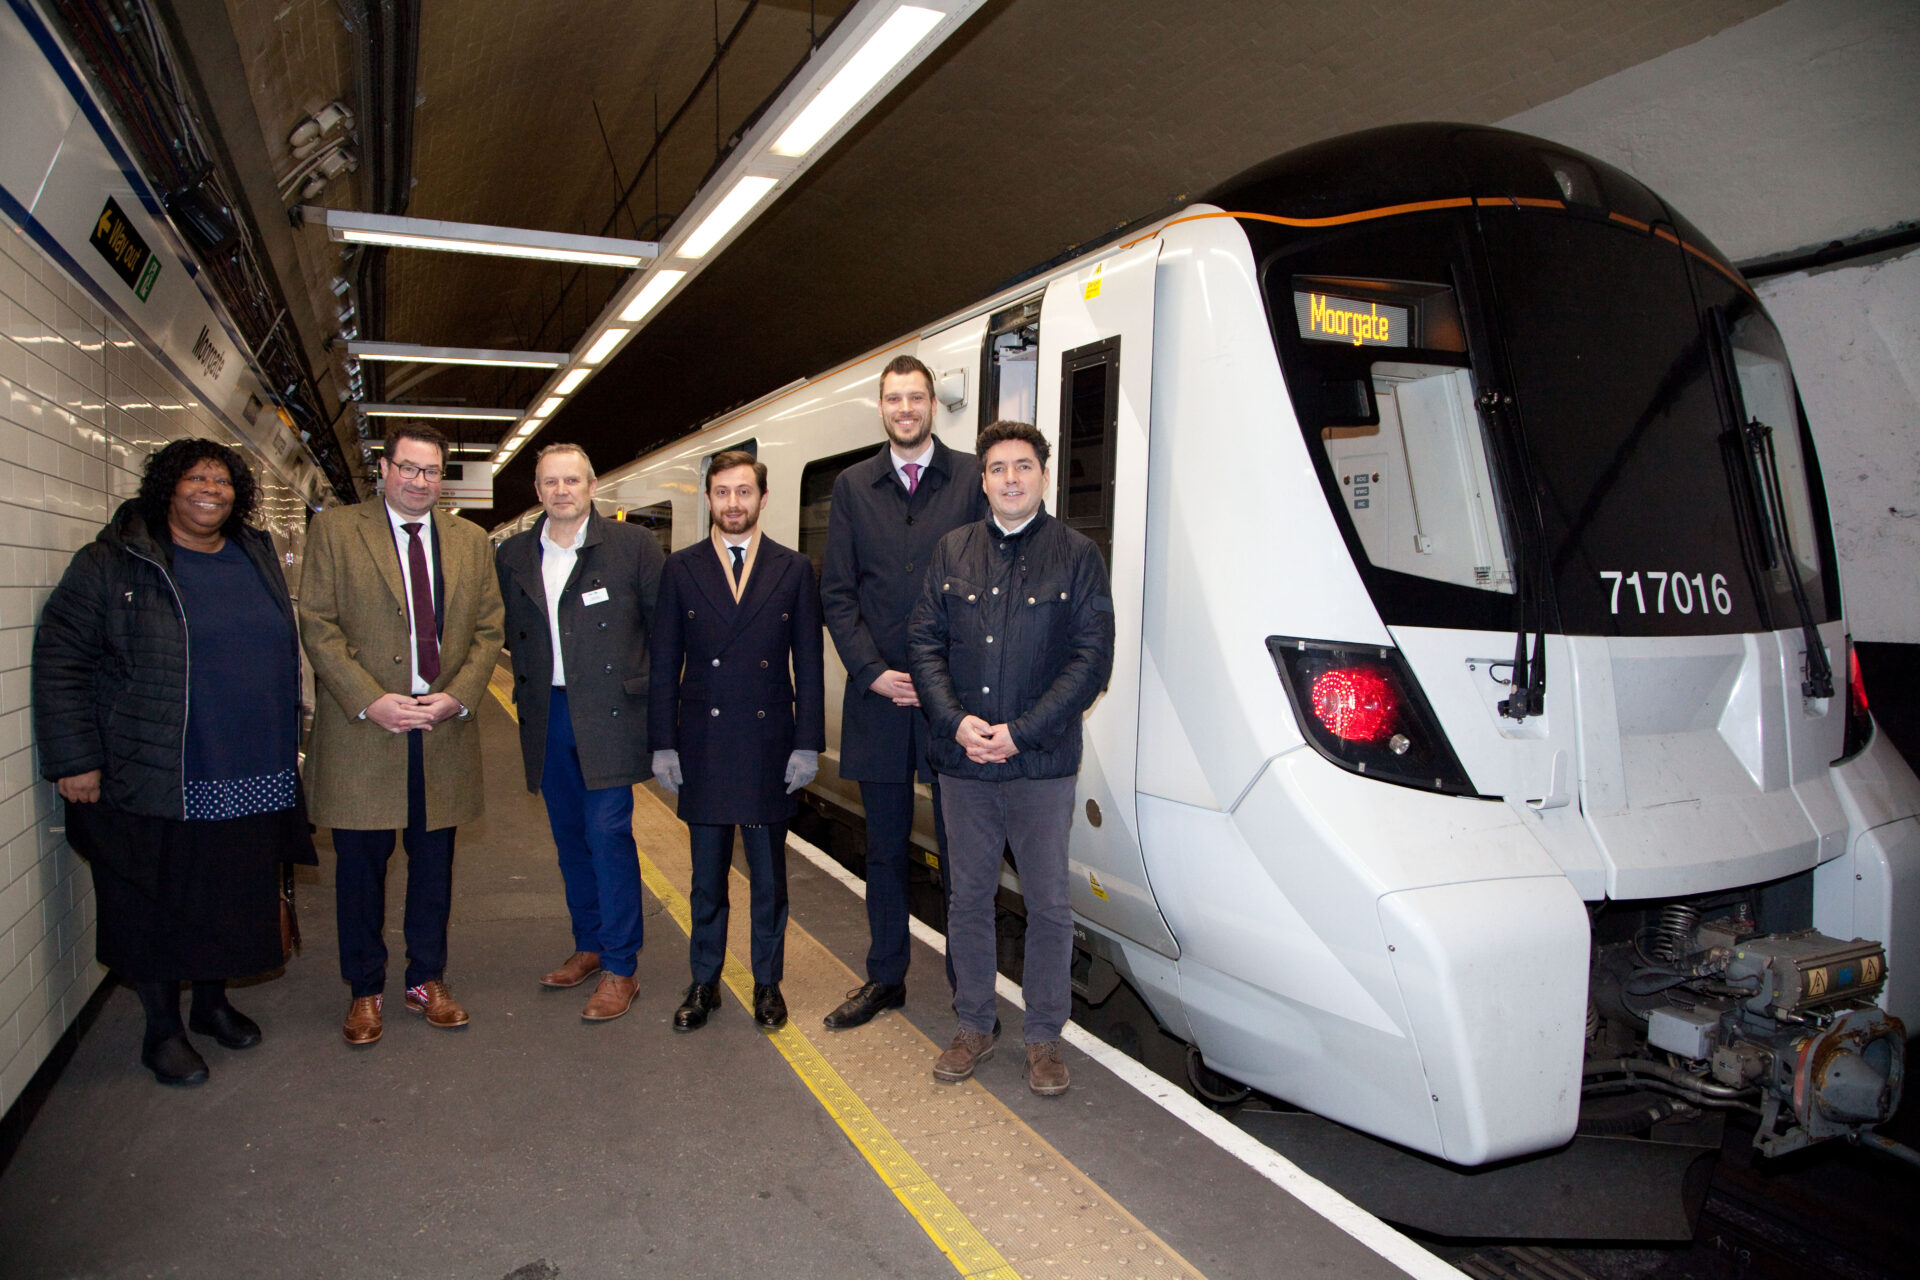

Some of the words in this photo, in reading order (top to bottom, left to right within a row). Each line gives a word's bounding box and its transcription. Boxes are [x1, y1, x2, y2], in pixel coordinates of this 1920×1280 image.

[108, 218, 130, 262] Way
[123, 244, 142, 272] out
[1310, 293, 1389, 346] Moorgate
[192, 324, 224, 379] Moorgate
[1600, 571, 1732, 615] 717016
